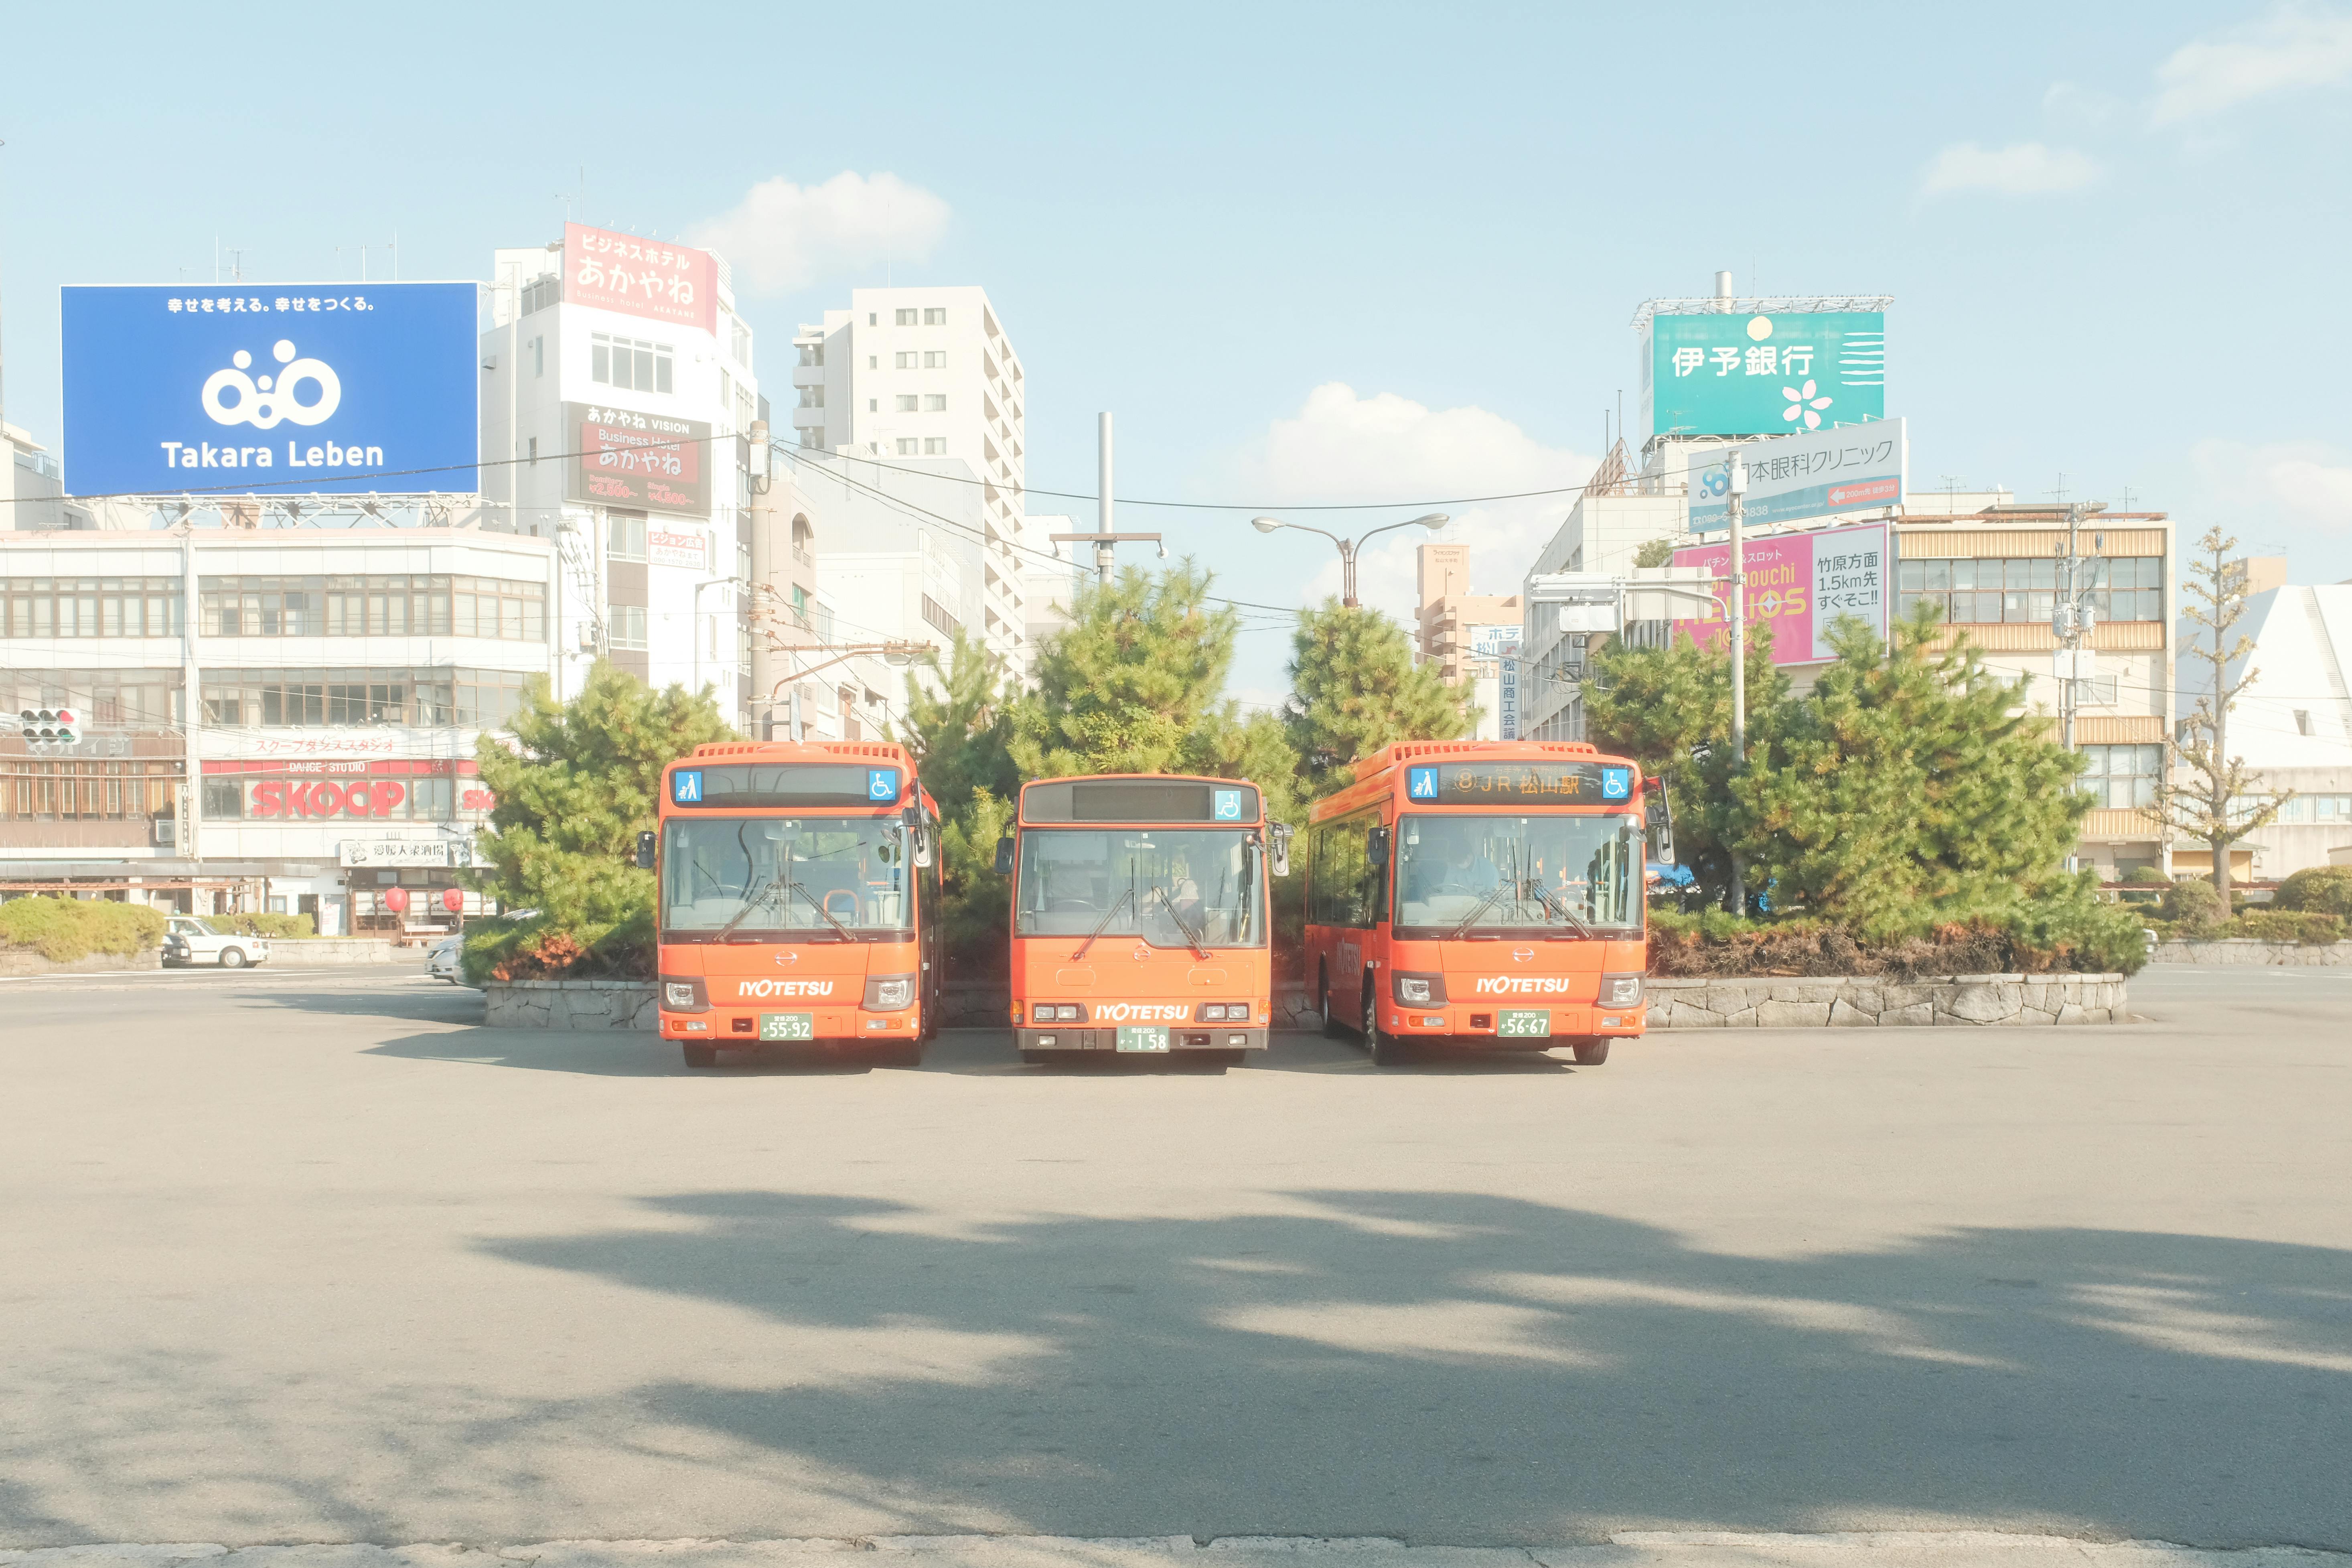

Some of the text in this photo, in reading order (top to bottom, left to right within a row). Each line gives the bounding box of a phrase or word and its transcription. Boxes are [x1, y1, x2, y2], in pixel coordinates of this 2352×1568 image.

[582, 233, 690, 270] ビジネスホテル
[577, 256, 695, 305] あかやね
[577, 290, 695, 318] Business hotel AKAYANE
[1672, 345, 1814, 377] 伊予銀行
[588, 407, 689, 434] あかやね VISION
[598, 428, 681, 452] Business Hotel
[161, 441, 384, 468] Takara Leben
[598, 442, 682, 476] あかやね
[647, 481, 670, 492] Single
[1846, 487, 1871, 498] 200m先
[651, 533, 703, 549] ビジョン広告
[1703, 549, 1782, 567] パチン&スロット
[1817, 552, 1878, 573] 竹原方面
[1819, 571, 1878, 592] 1.5km先
[1818, 591, 1878, 610] すぐそこ!!
[1489, 628, 1520, 640] ホテ
[256, 738, 395, 752] スクープダンススタジオ
[289, 763, 365, 772] DANCE STUDIO
[1519, 775, 1579, 794] 松山駅
[253, 781, 405, 816] SKOOP
[463, 789, 496, 809] SK
[373, 844, 444, 856] 愛媛大衆酒場
[738, 979, 833, 997] IYOTETSU
[1476, 976, 1569, 994] IYOTETSU
[1095, 1003, 1188, 1021] IYOTETSU
[769, 1022, 810, 1037] 55-92
[1508, 1018, 1547, 1034] 56-67
